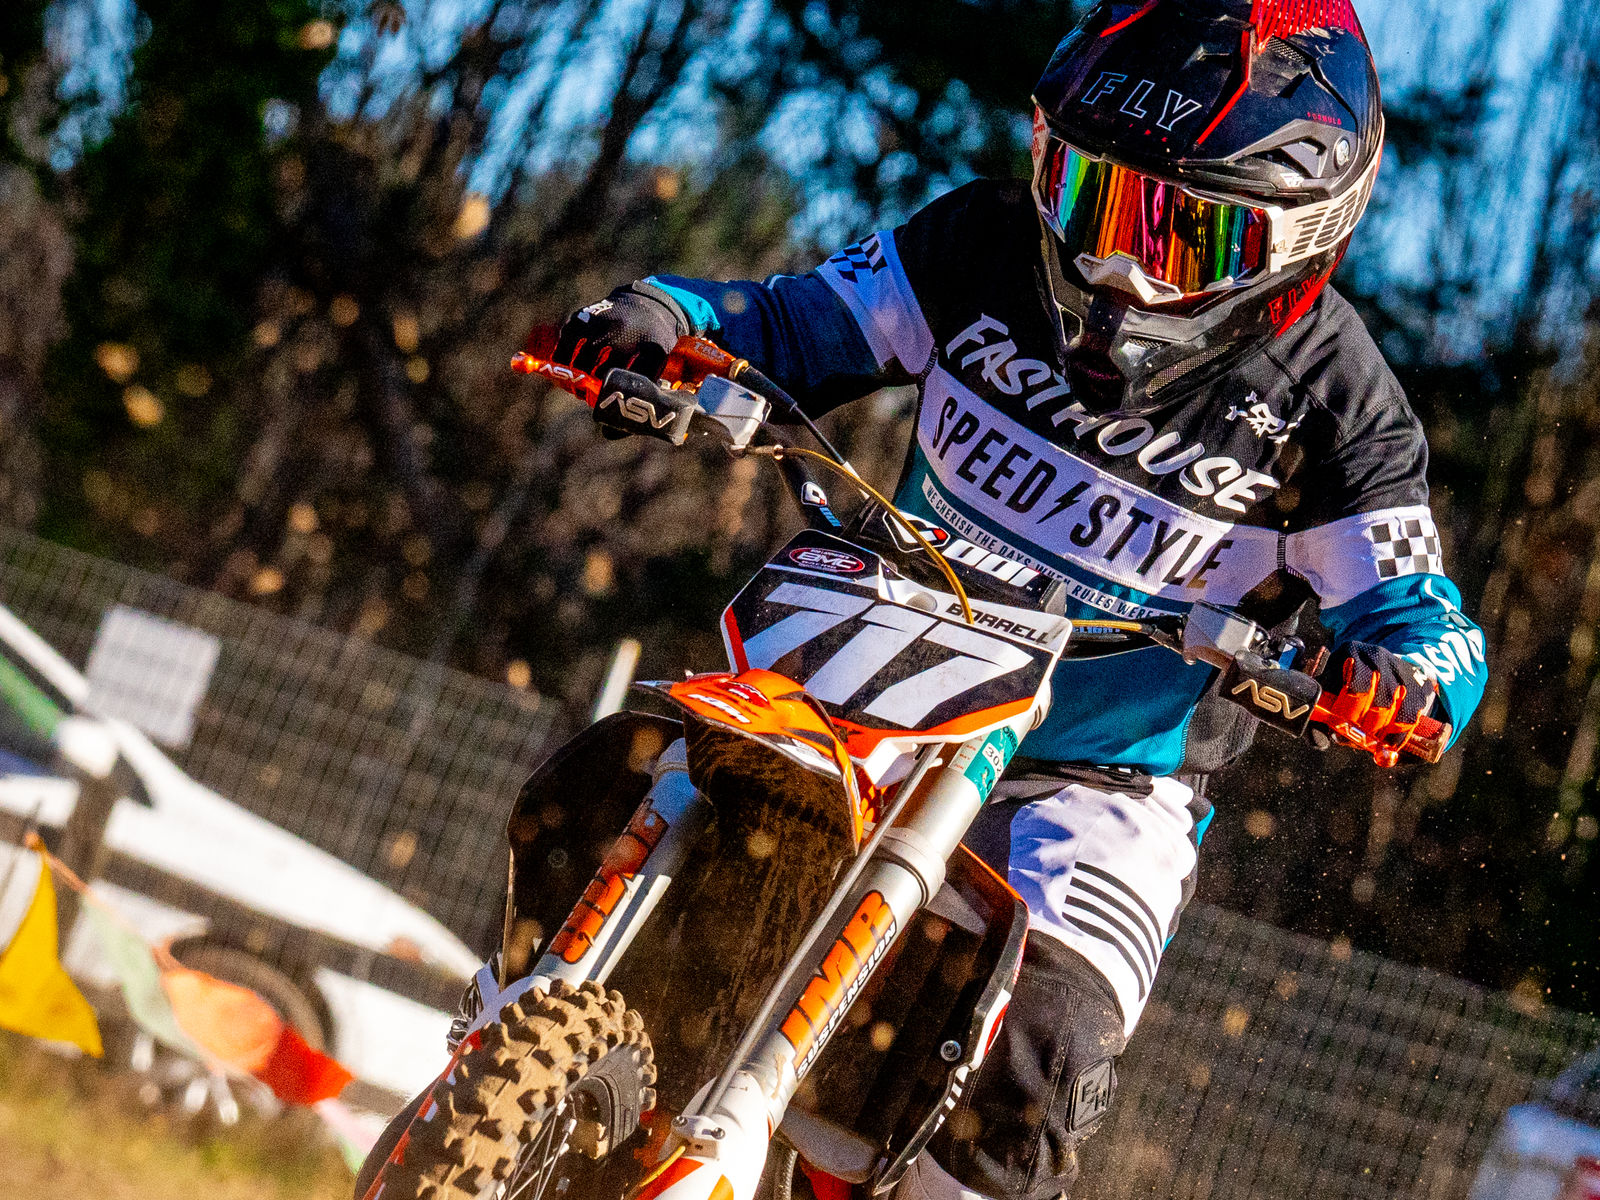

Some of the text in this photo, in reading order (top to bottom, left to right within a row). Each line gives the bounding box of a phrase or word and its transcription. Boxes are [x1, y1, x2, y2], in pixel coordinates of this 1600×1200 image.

[1081, 72, 1202, 131] FLY
[539, 363, 585, 382] ASV
[600, 391, 676, 428] ASV
[932, 396, 1234, 589] SPEED STYLE
[926, 486, 938, 503] WE
[935, 499, 974, 536] CHERISH
[974, 530, 997, 550] THE
[998, 545, 1031, 567] DAYS
[1072, 584, 1113, 609] RULES
[1117, 602, 1153, 619] WERE
[743, 582, 1034, 728] 777
[1231, 679, 1310, 720] ASV
[1336, 722, 1378, 747] ASV
[795, 922, 898, 1078] SUSPENSION
